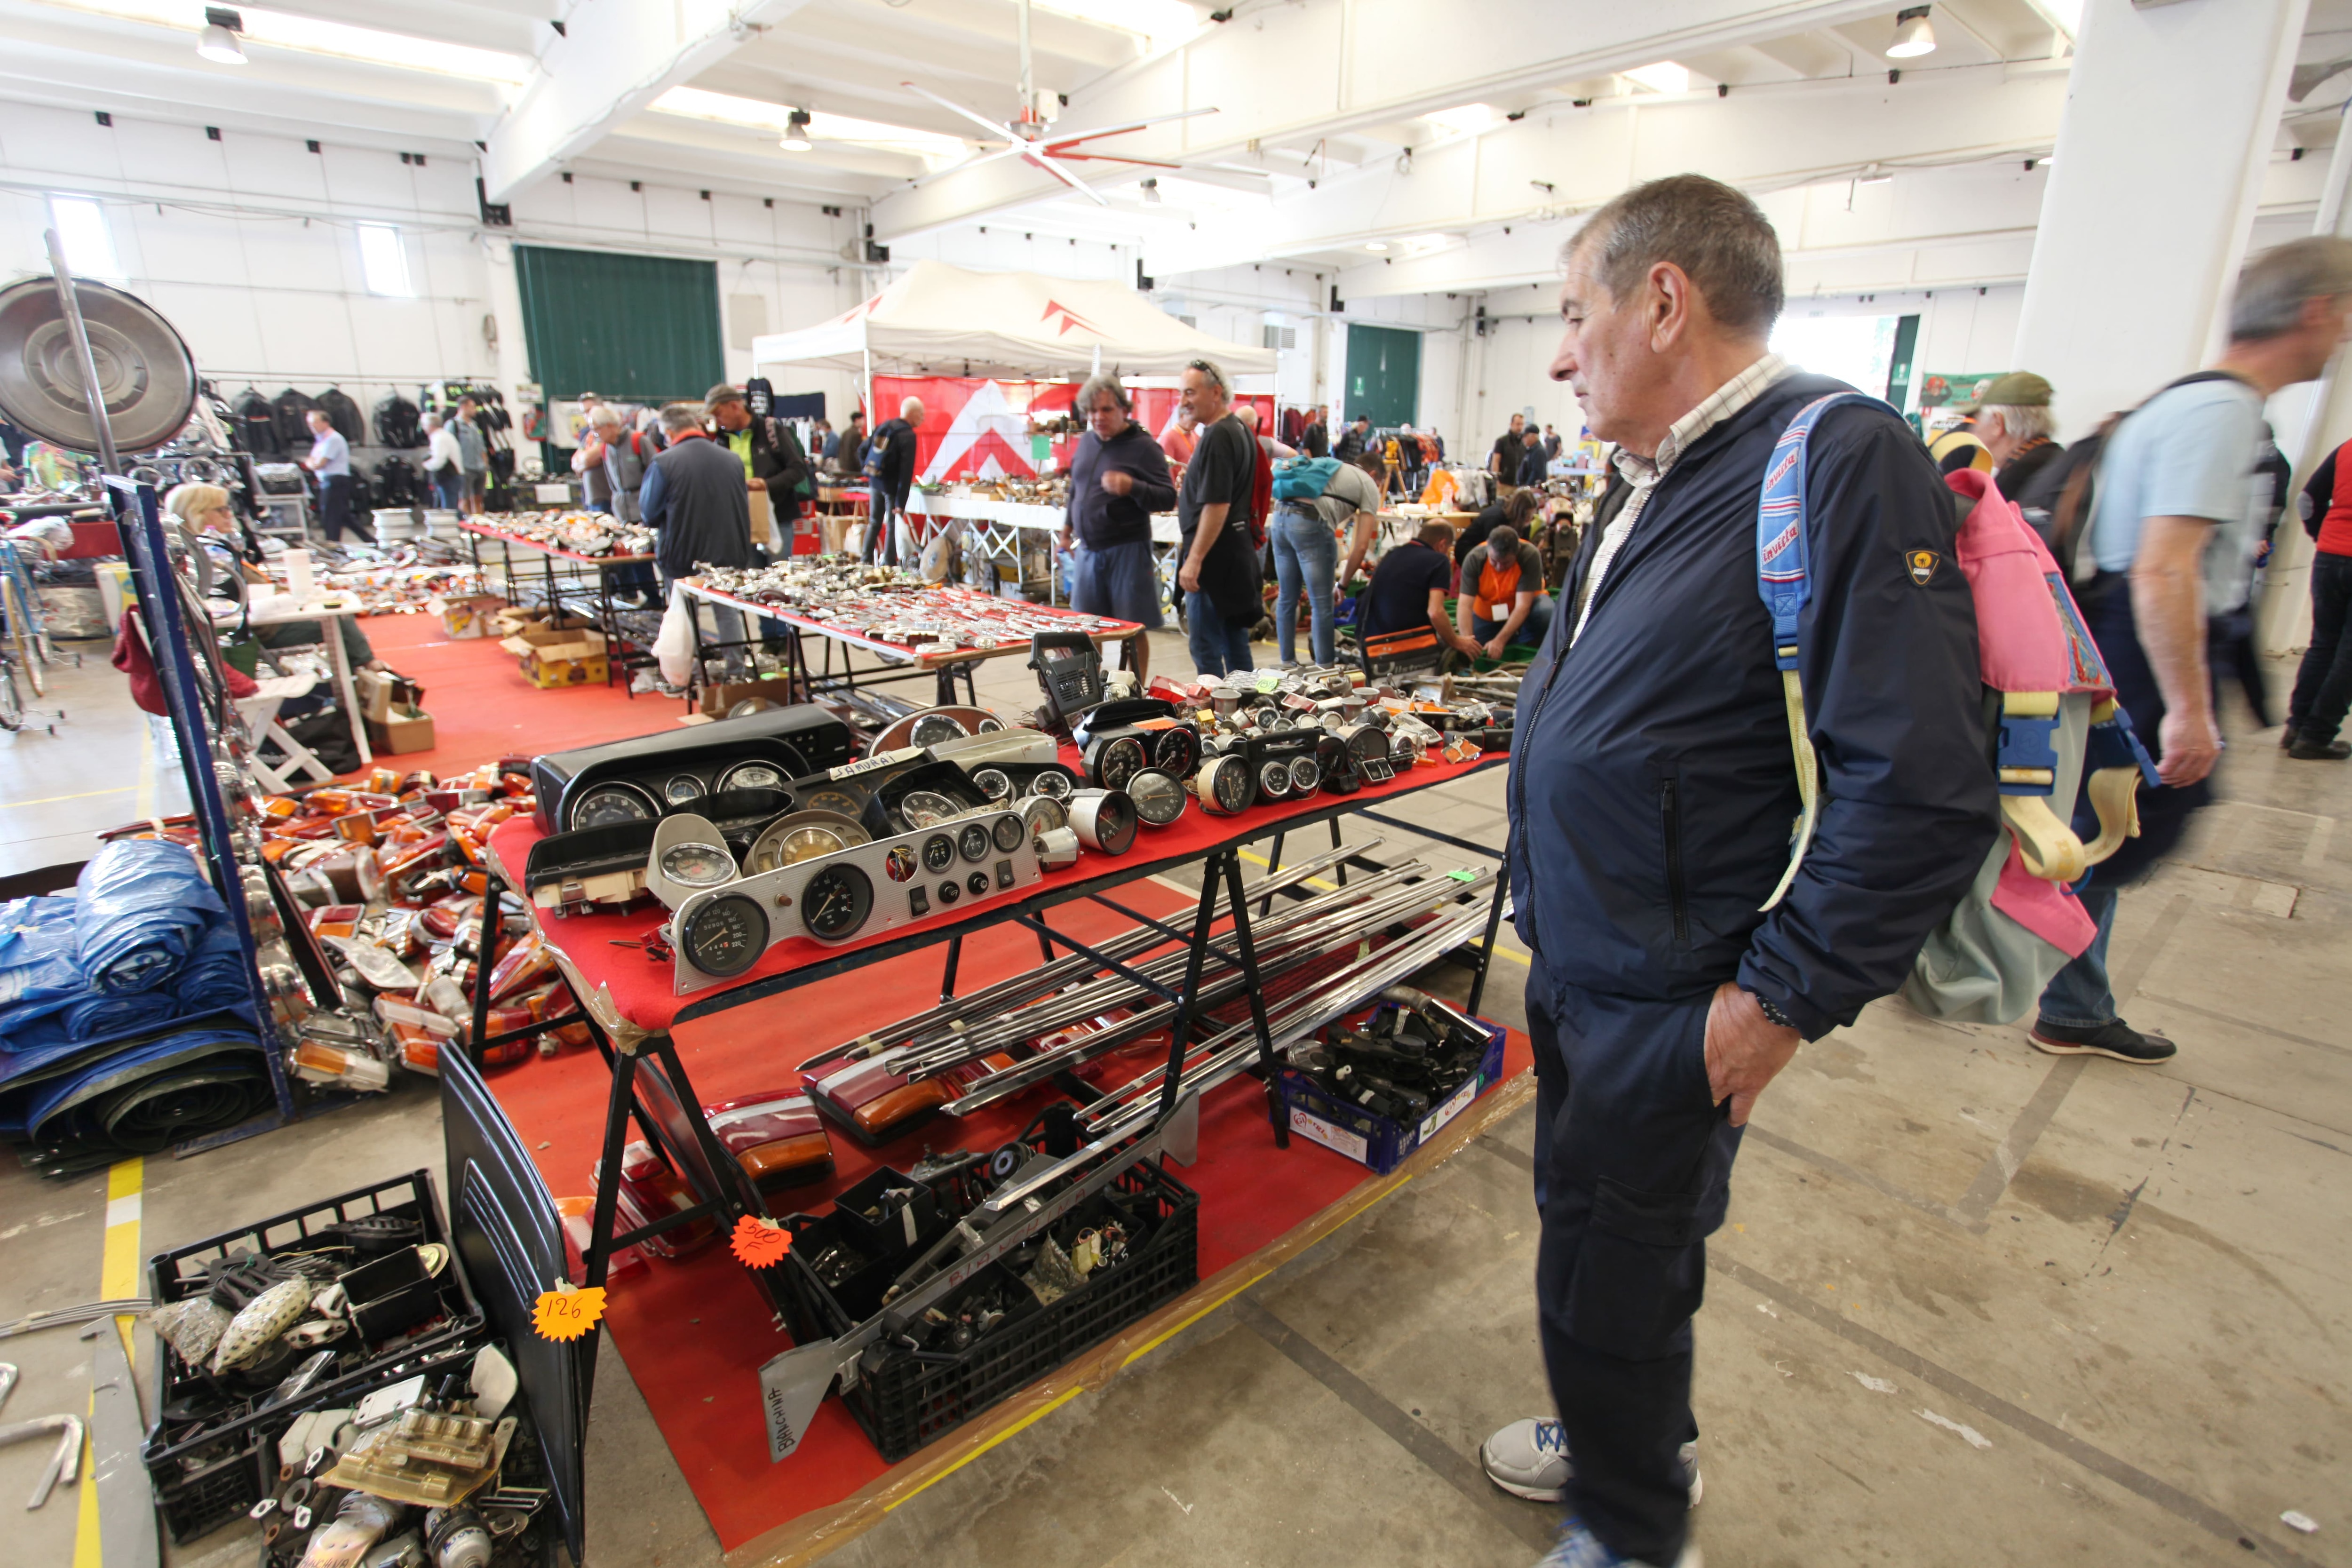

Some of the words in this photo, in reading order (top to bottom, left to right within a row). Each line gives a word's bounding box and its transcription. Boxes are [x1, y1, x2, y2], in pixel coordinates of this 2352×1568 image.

[1765, 453, 1796, 491] invicta
[1763, 526, 1797, 562] invicta
[834, 755, 896, 778] SAMURAI
[743, 1223, 781, 1243] 500
[948, 1188, 1086, 1288] BIANCHINA
[546, 1297, 584, 1318] 126
[768, 1387, 796, 1452] BIANCHINA
